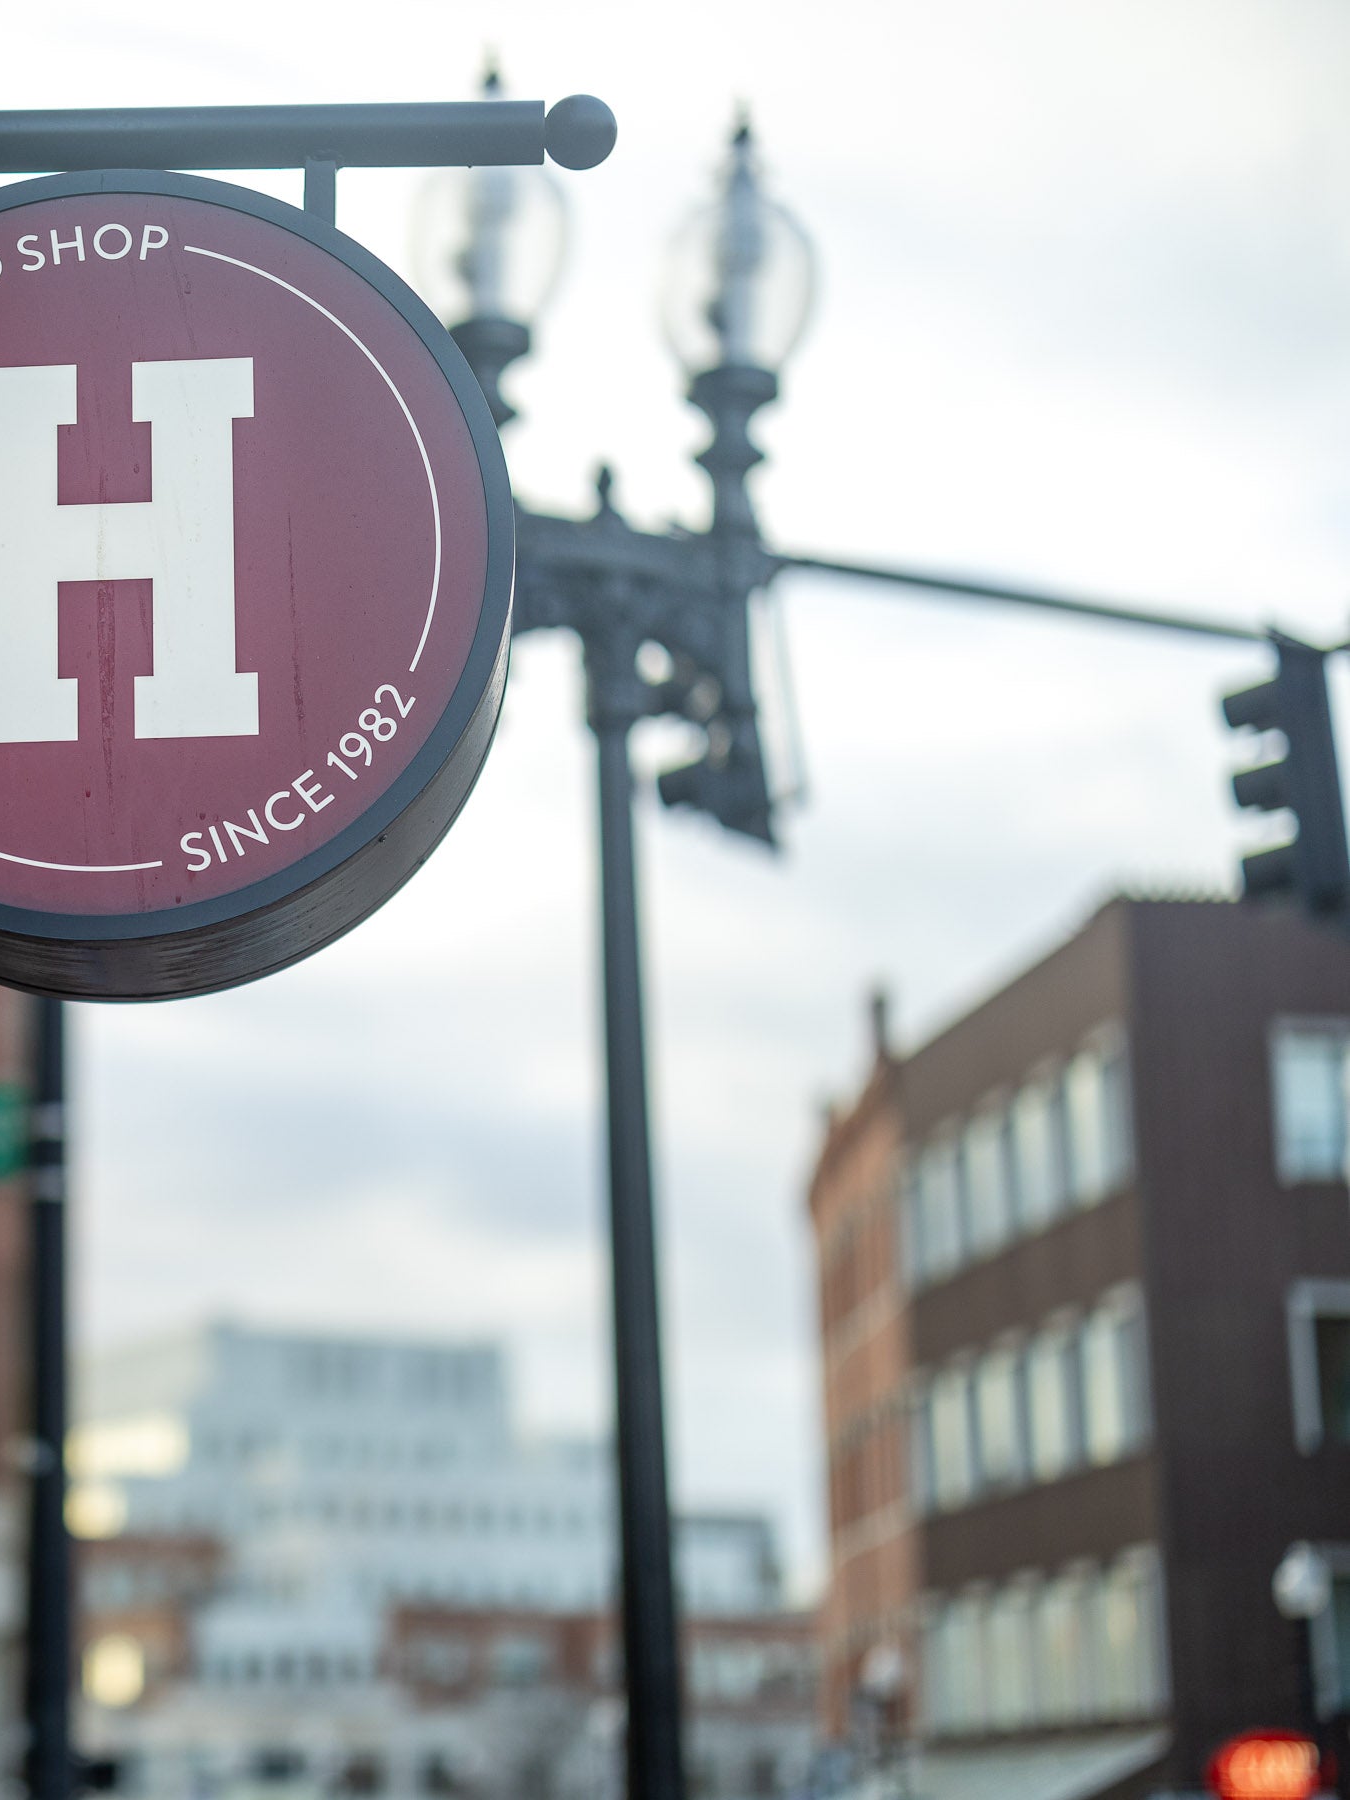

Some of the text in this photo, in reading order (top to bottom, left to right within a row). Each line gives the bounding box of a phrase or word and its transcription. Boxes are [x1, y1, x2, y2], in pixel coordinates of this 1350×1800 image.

[16, 223, 169, 272] SHOP
[179, 683, 417, 872] SINCE 1982
